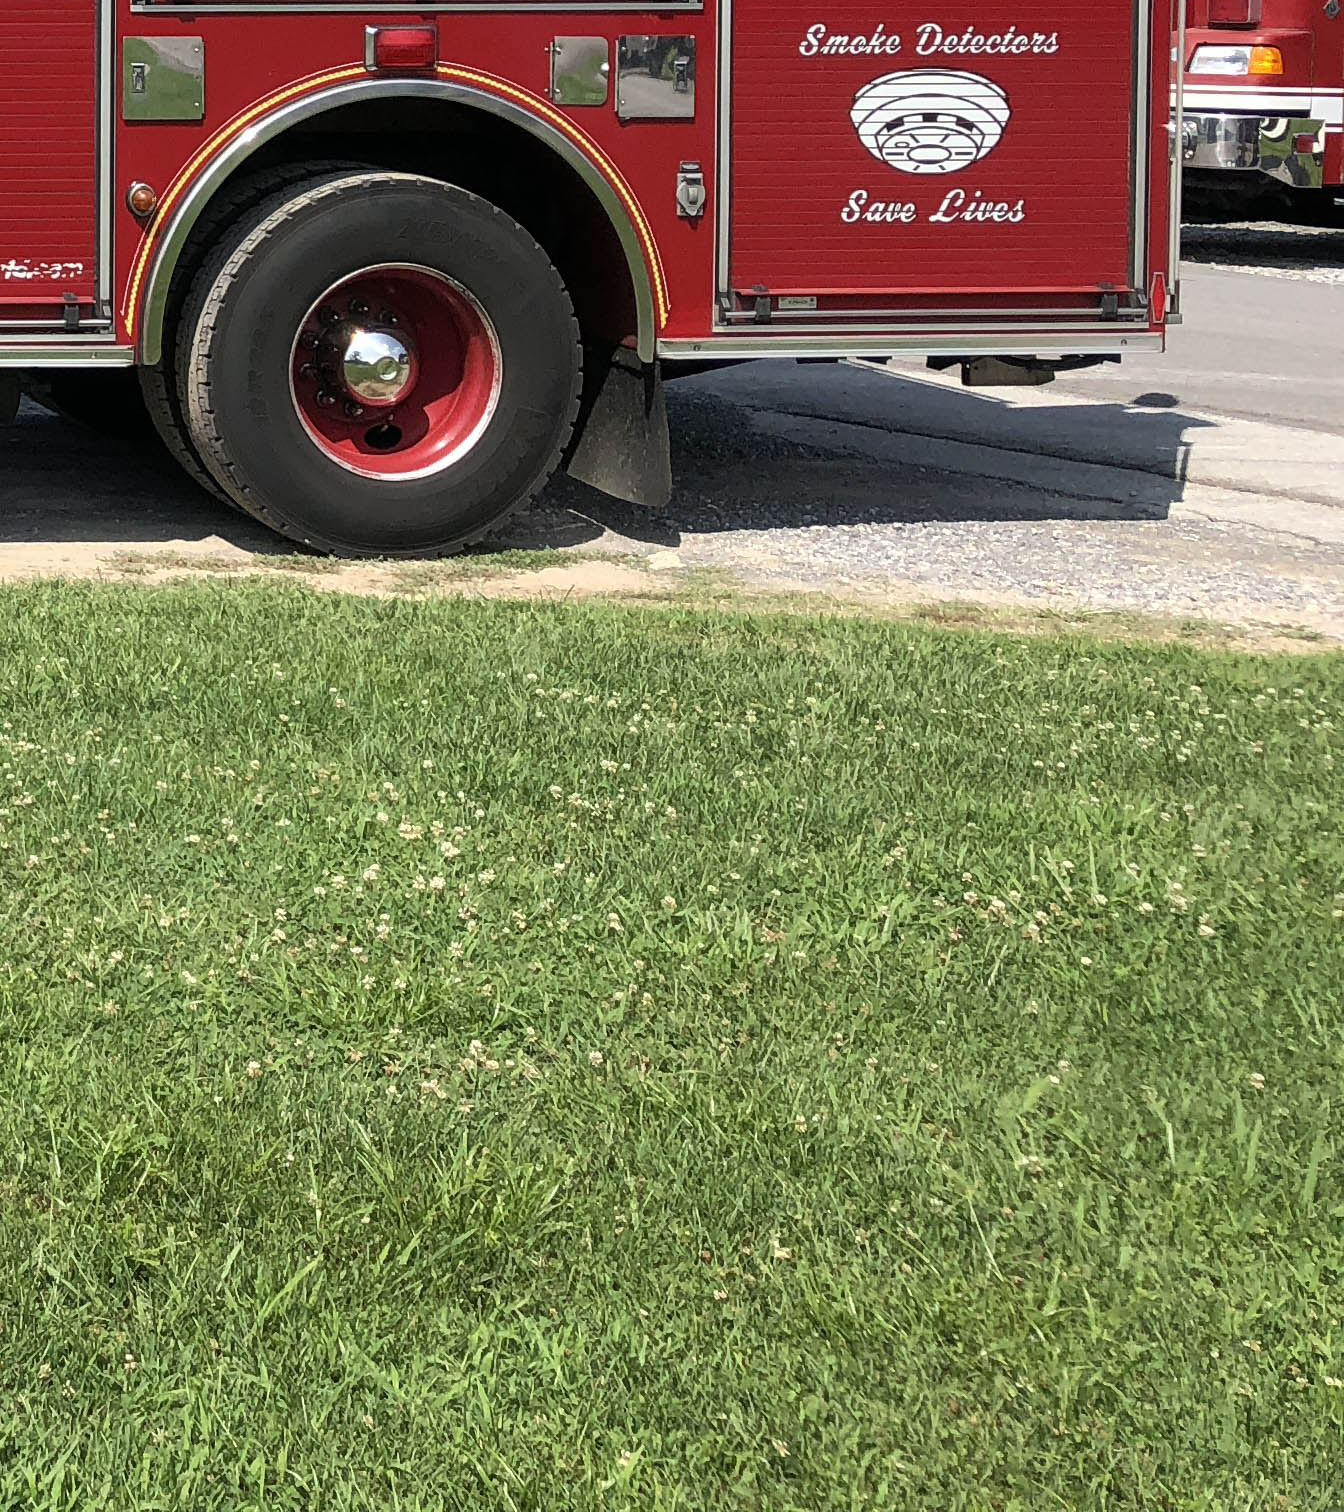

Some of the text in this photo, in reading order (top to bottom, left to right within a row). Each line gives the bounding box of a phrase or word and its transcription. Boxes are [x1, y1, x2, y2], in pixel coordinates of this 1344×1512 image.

[798, 22, 1060, 57] Smoke Detectors
[840, 188, 1026, 224] Save Lives
